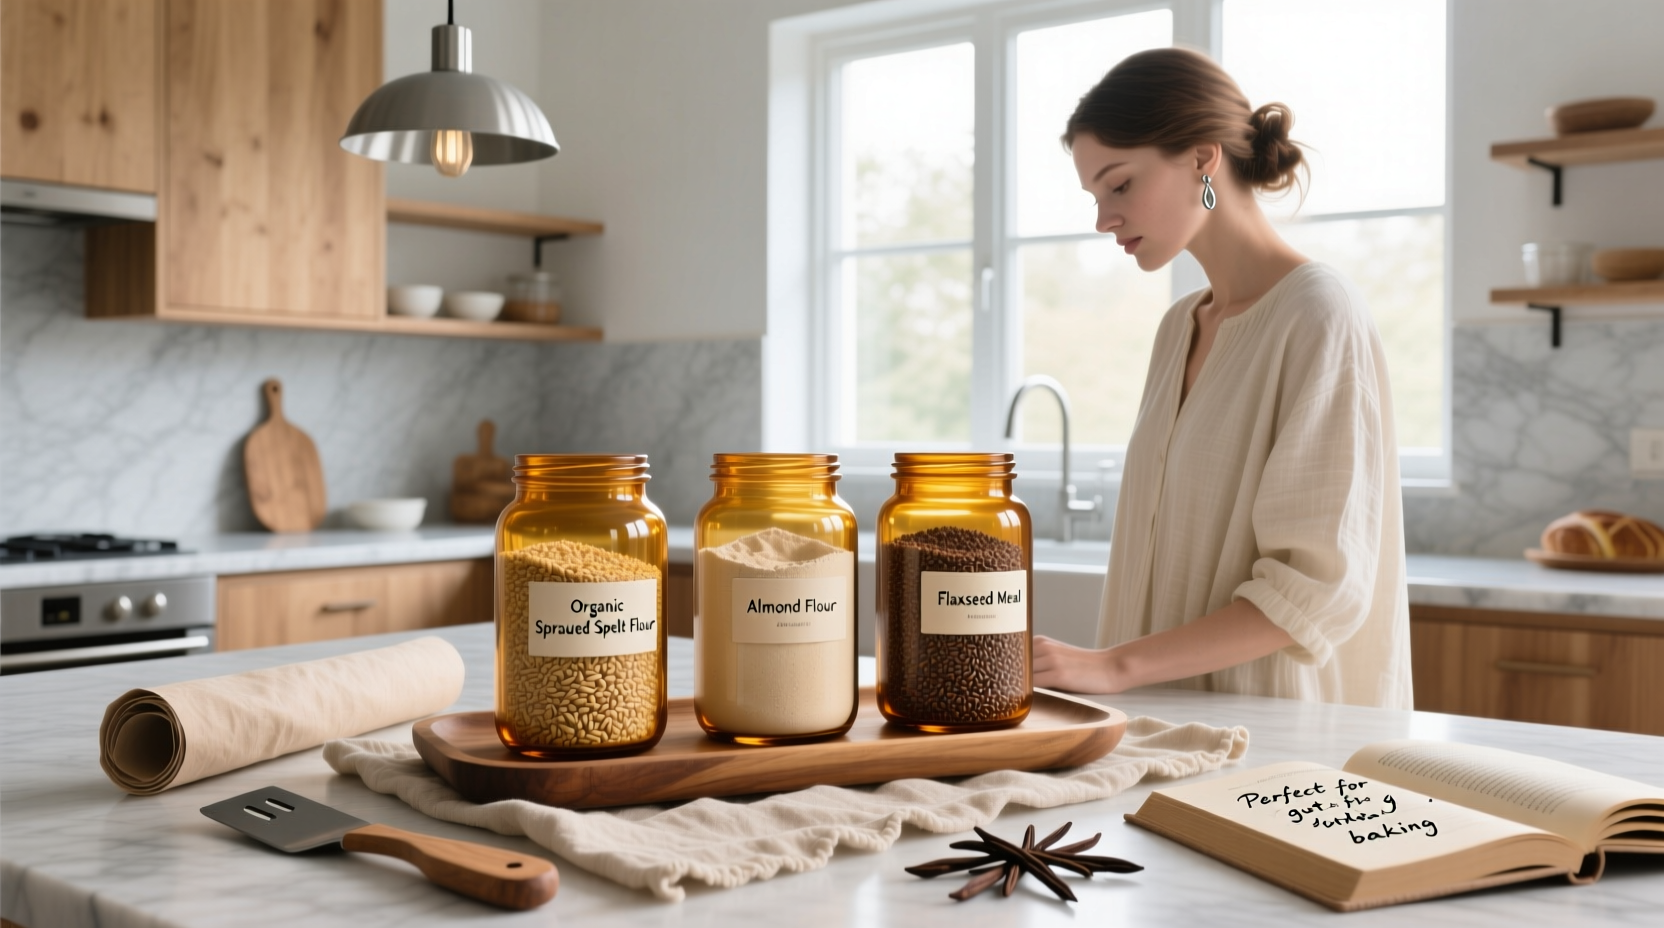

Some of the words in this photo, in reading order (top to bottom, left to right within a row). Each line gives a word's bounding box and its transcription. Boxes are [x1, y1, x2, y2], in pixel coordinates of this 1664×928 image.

[570, 598, 624, 618] Organic
[747, 598, 801, 614] Almond
[805, 598, 837, 613] Flour
[938, 591, 994, 606] Flaxseed
[997, 589, 1021, 605] Meal
[594, 619, 626, 639] Spelt
[630, 617, 656, 633] Flour
[1237, 782, 1326, 809] Perfect
[1335, 779, 1369, 796] for
[1349, 819, 1438, 844] baking
